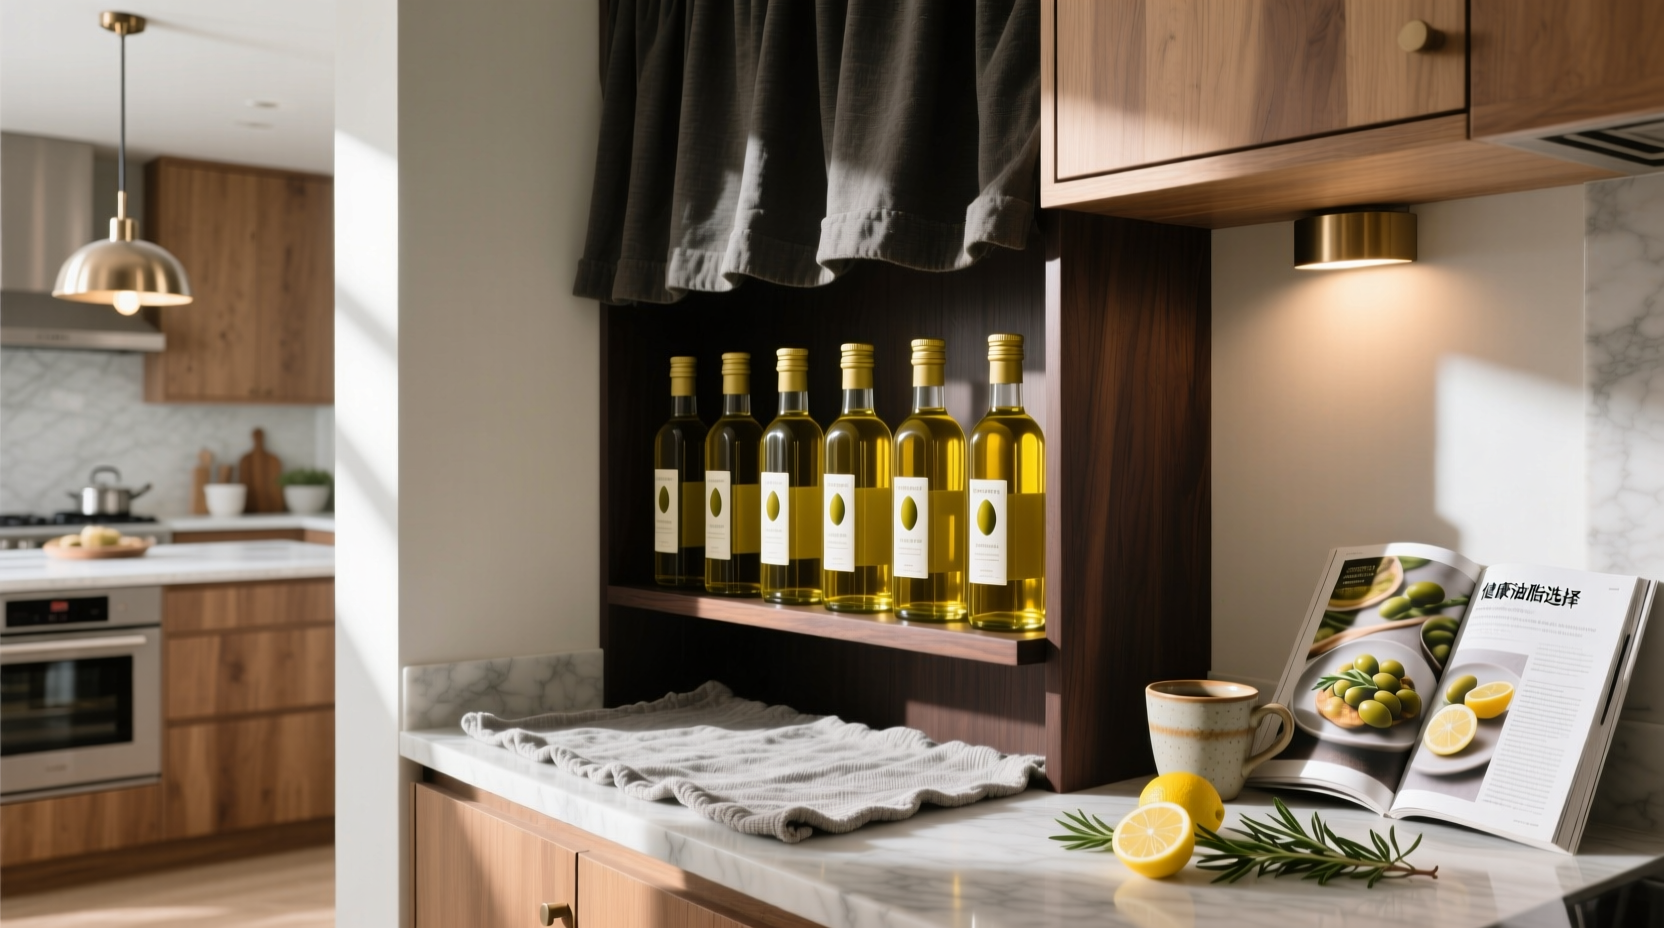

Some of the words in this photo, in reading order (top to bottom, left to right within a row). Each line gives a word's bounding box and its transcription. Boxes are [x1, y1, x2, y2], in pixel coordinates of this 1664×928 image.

[1481, 582, 1581, 609] 健康油脂选择
